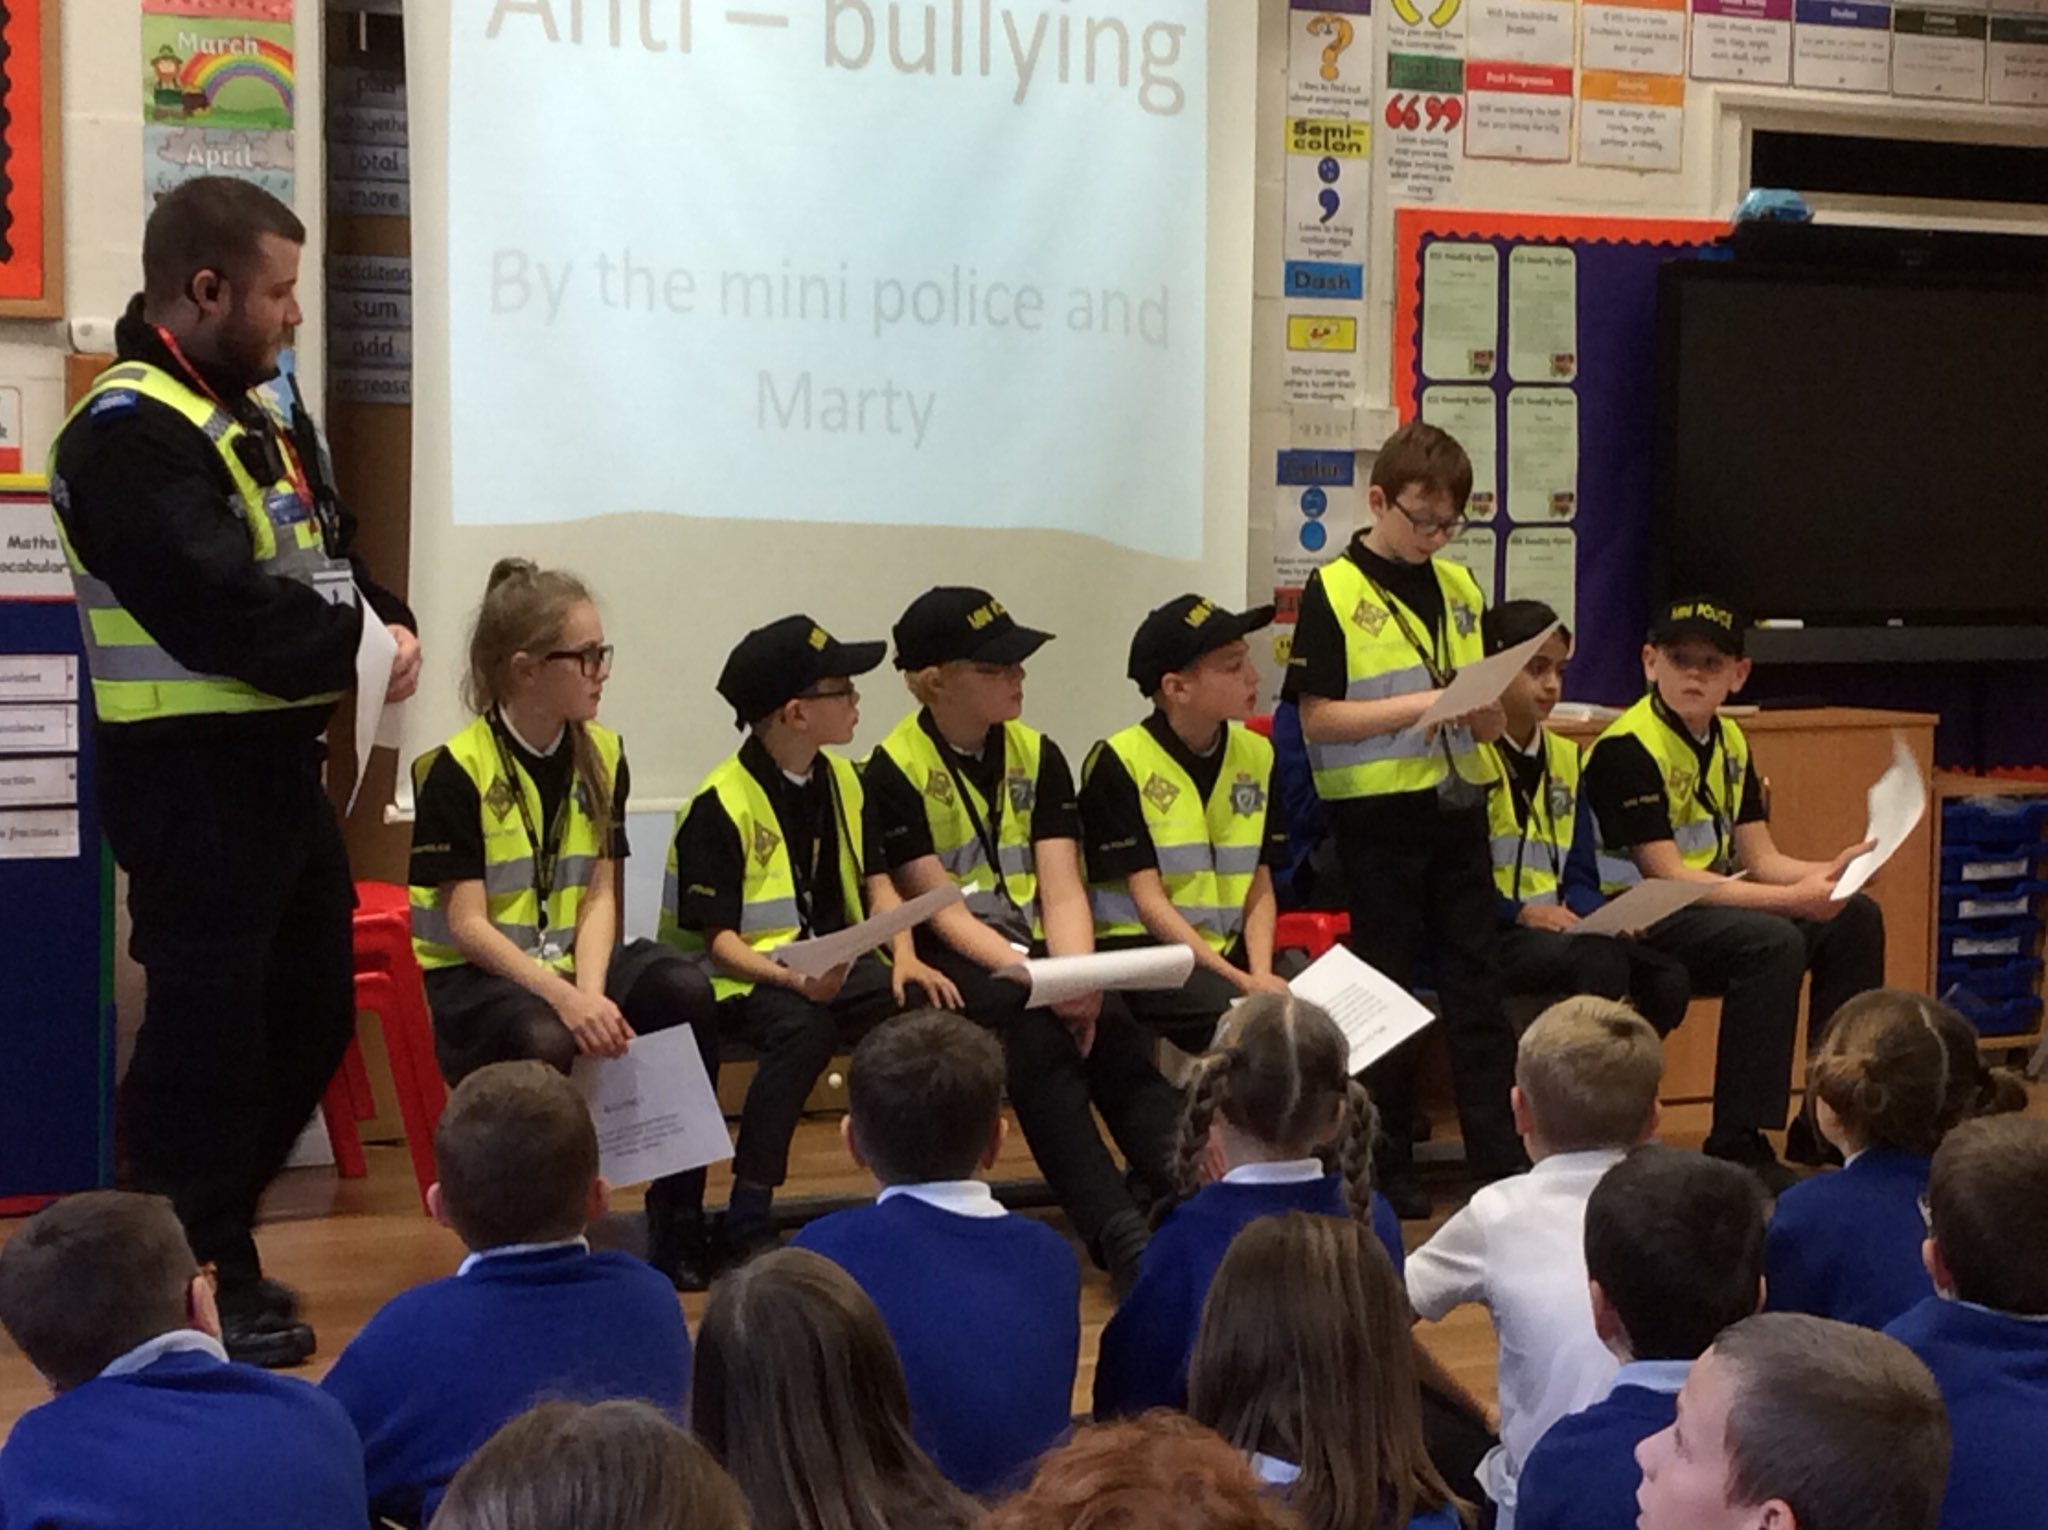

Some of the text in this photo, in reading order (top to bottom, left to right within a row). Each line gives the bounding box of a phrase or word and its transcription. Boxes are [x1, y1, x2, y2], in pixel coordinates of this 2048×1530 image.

[177, 30, 261, 56] March
[823, 0, 1188, 118] bullying
[1293, 121, 1365, 138] Semi-
[1293, 133, 1362, 153] colon
[186, 142, 254, 170] April
[352, 151, 399, 172] total
[349, 187, 402, 208] more
[1294, 269, 1351, 290] Dash
[490, 246, 1171, 350] By the mini police and
[352, 300, 401, 319] sum
[352, 335, 396, 358] add
[756, 369, 937, 450] Marty
[1284, 455, 1343, 479] Colon
[6, 534, 58, 550] Maths
[0, 557, 68, 574] ocabular
[1696, 602, 1733, 631] POLICE
